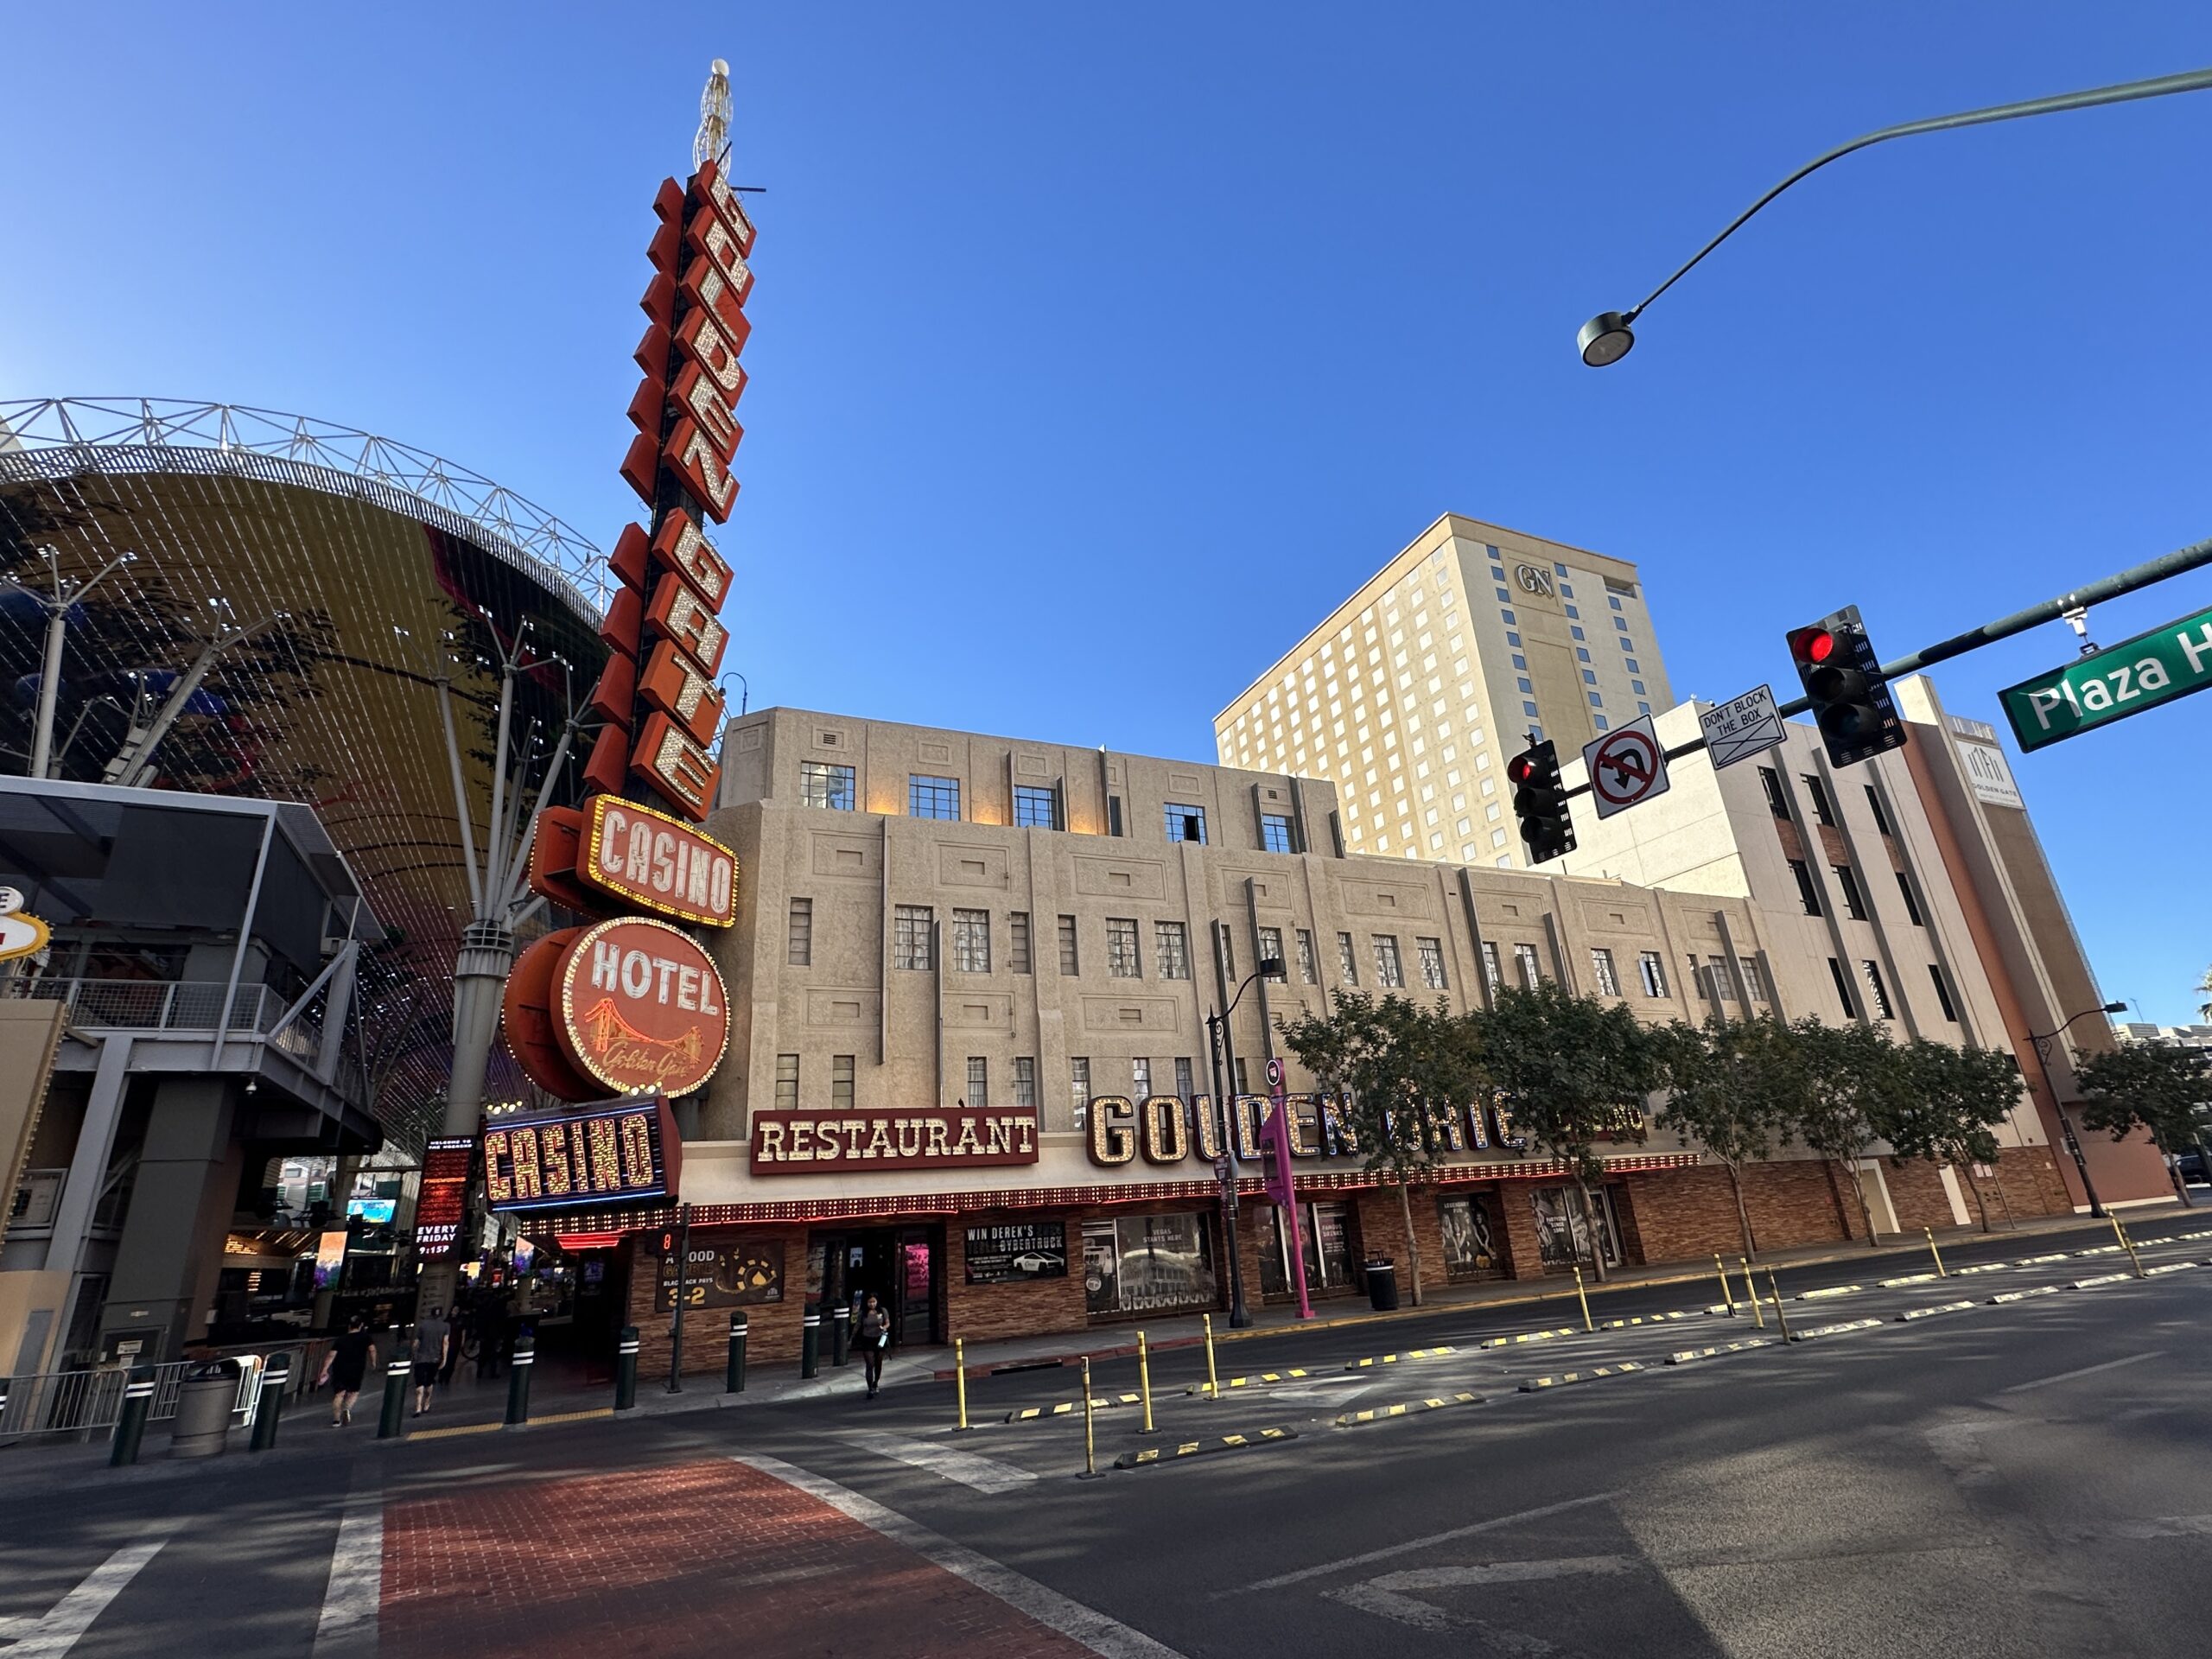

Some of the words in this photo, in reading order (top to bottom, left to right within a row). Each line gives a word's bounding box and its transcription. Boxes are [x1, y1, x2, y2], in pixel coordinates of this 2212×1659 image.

[681, 170, 752, 511] GOLDEN
[1516, 564, 1554, 597] GN
[652, 520, 728, 808] GATE
[1703, 707, 1731, 728] DON'T
[1733, 690, 1767, 714] BLOCK
[2028, 658, 2171, 730] Plaza
[1717, 720, 1737, 736] THE
[1740, 709, 1762, 726] BOX
[601, 810, 732, 915] CASINO
[591, 939, 720, 1016] HOTEL
[757, 1116, 1037, 1163] RESTAURANT
[1088, 1092, 1359, 1165] GOLDEN
[484, 1115, 654, 1201] CASINO
[416, 1233, 456, 1243] FRIDAY
[417, 1224, 458, 1236] EVERY
[968, 1228, 988, 1241] WIN
[992, 1224, 1033, 1239] DEREK'S
[1000, 1236, 1063, 1252] CYBERTRUCK
[1142, 1235, 1166, 1243] STARTS
[419, 1245, 449, 1255] 9:15P
[687, 1250, 715, 1262] OOD
[663, 1278, 697, 1287] BLACACK
